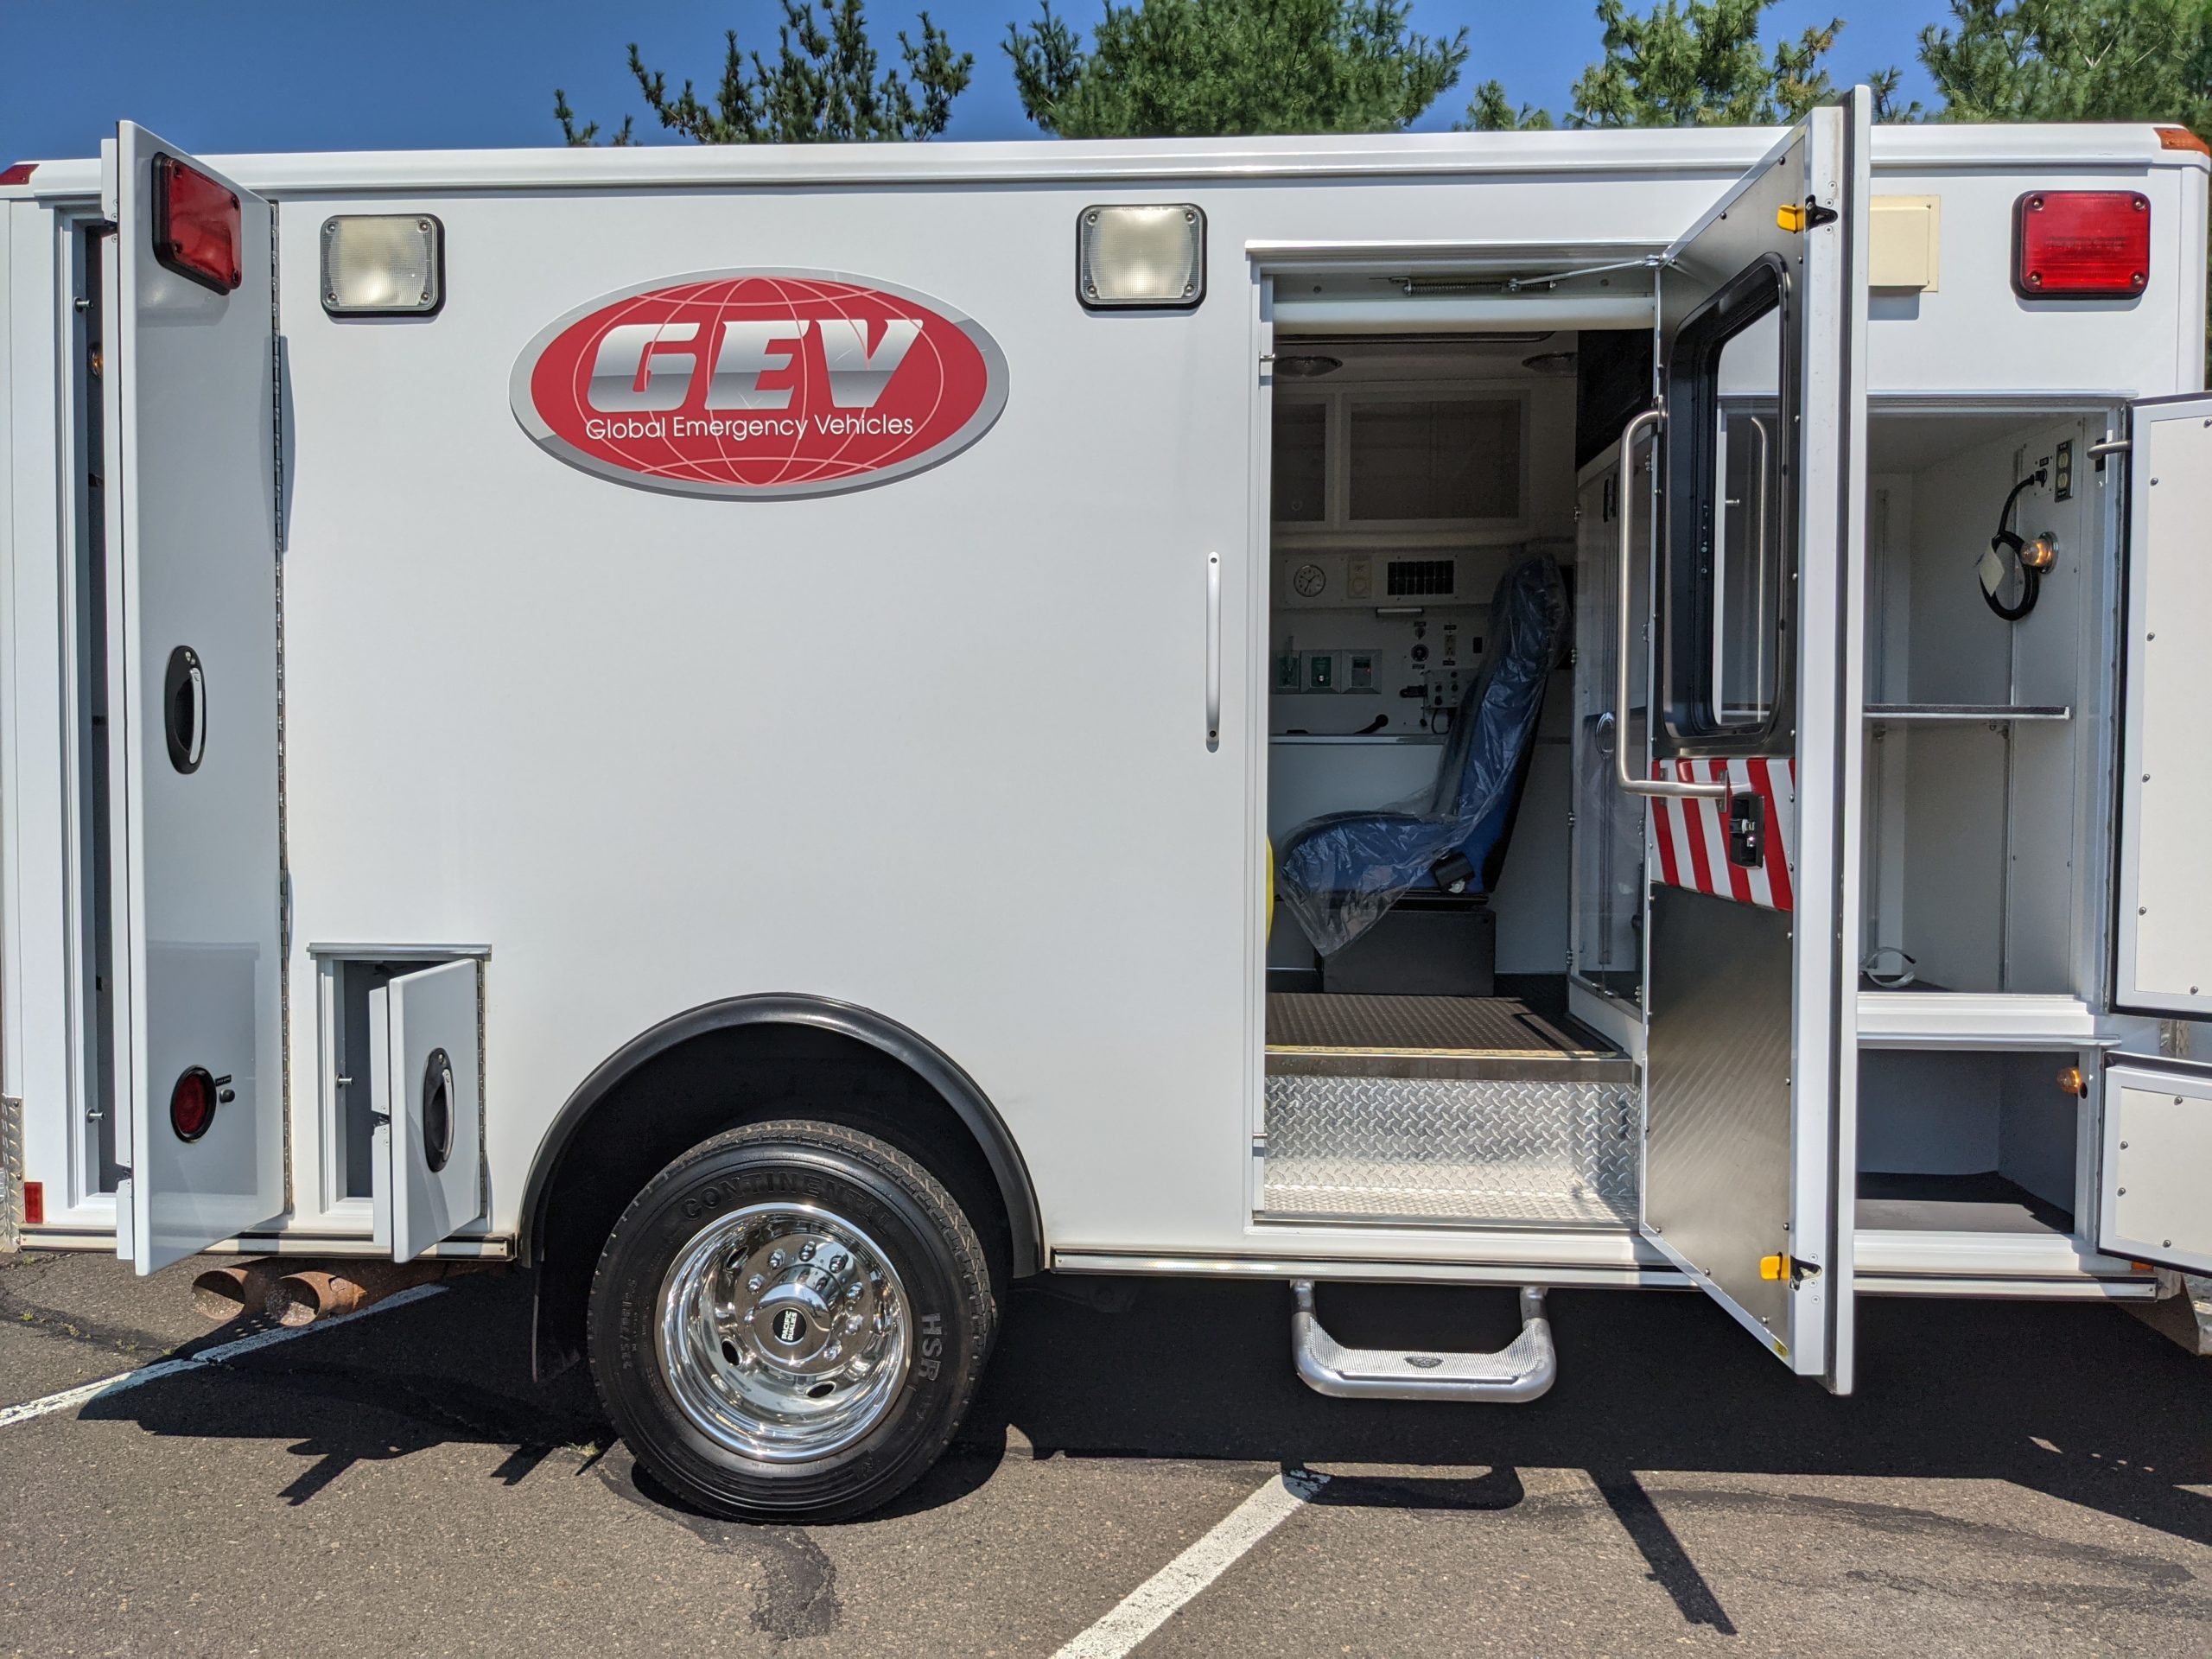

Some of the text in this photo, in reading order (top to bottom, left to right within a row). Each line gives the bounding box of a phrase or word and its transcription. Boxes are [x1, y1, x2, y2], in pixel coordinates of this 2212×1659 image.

[586, 319, 924, 412] GEV
[586, 413, 913, 442] Global Emergency Vehicles
[680, 1170, 893, 1238] CONTINENTAL
[781, 1310, 792, 1340] PACIFIC
[787, 1312, 798, 1341] DUALIES
[918, 1313, 943, 1382] HSR
